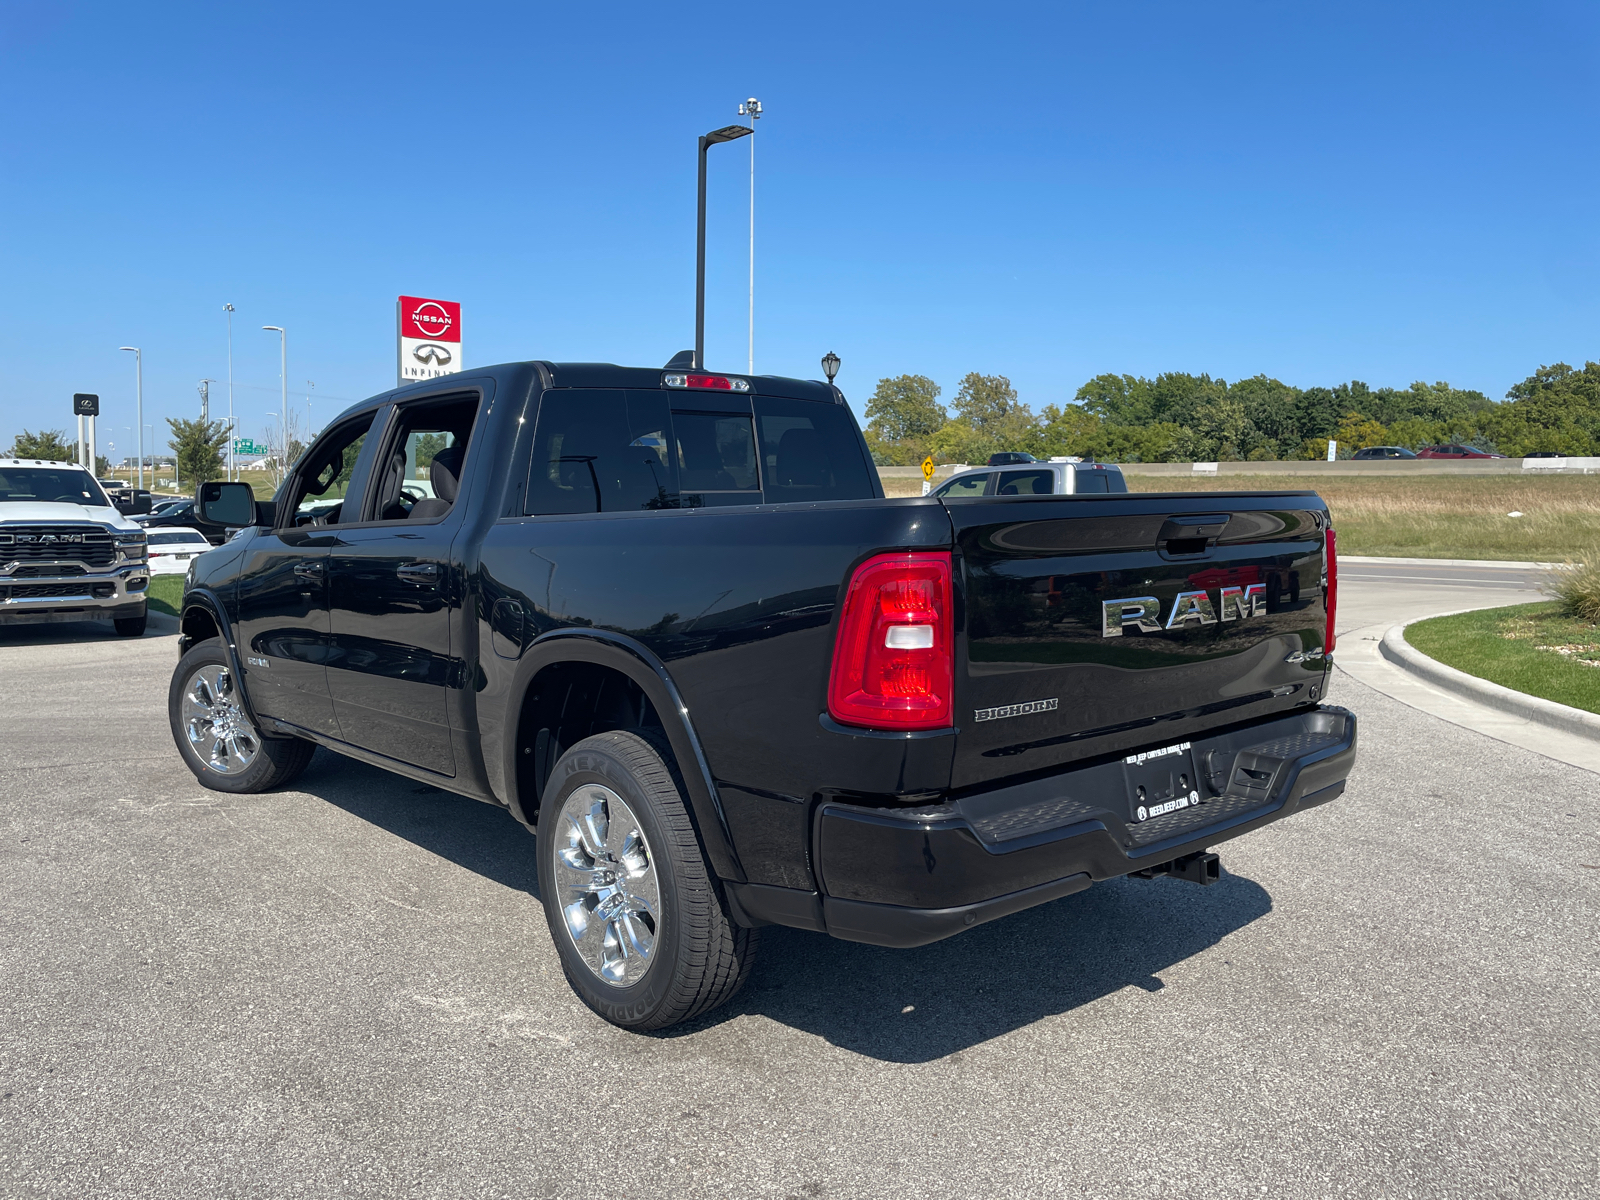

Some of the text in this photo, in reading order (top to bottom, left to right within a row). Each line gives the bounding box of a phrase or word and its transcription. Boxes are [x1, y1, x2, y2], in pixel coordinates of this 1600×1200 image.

[412, 313, 452, 325] NISSAN
[404, 367, 454, 378] INFINI
[16, 534, 82, 544] RAM
[1102, 583, 1267, 638] RAM
[974, 698, 1059, 722] BIGHORN
[1137, 753, 1146, 761] JEEP
[1147, 748, 1167, 759] CHRYSLER
[1167, 744, 1180, 753] DODGE
[1180, 741, 1191, 751] RAM
